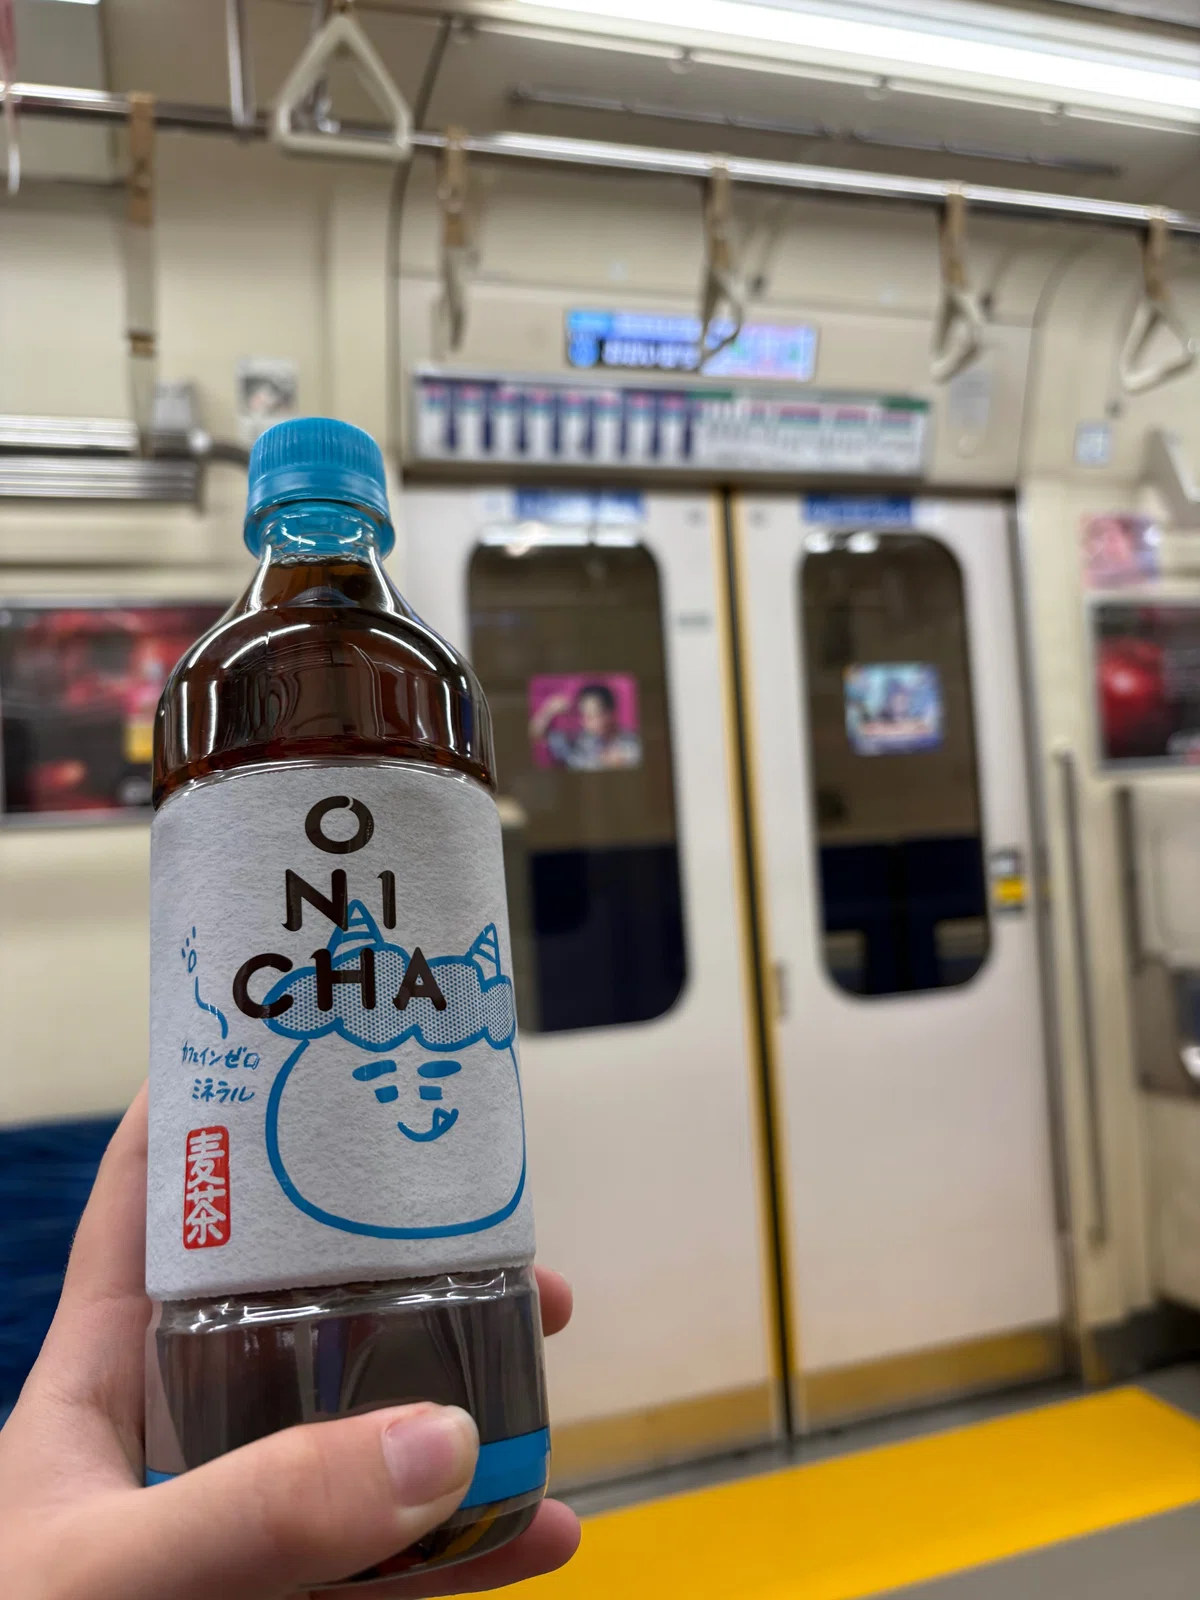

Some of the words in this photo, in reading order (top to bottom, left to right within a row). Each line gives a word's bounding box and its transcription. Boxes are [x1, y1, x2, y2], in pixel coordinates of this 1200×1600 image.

[305, 796, 374, 854] O
[233, 947, 447, 1019] CHA
[192, 1078, 255, 1103] ミネラル
[186, 1130, 227, 1245] 麦茶
